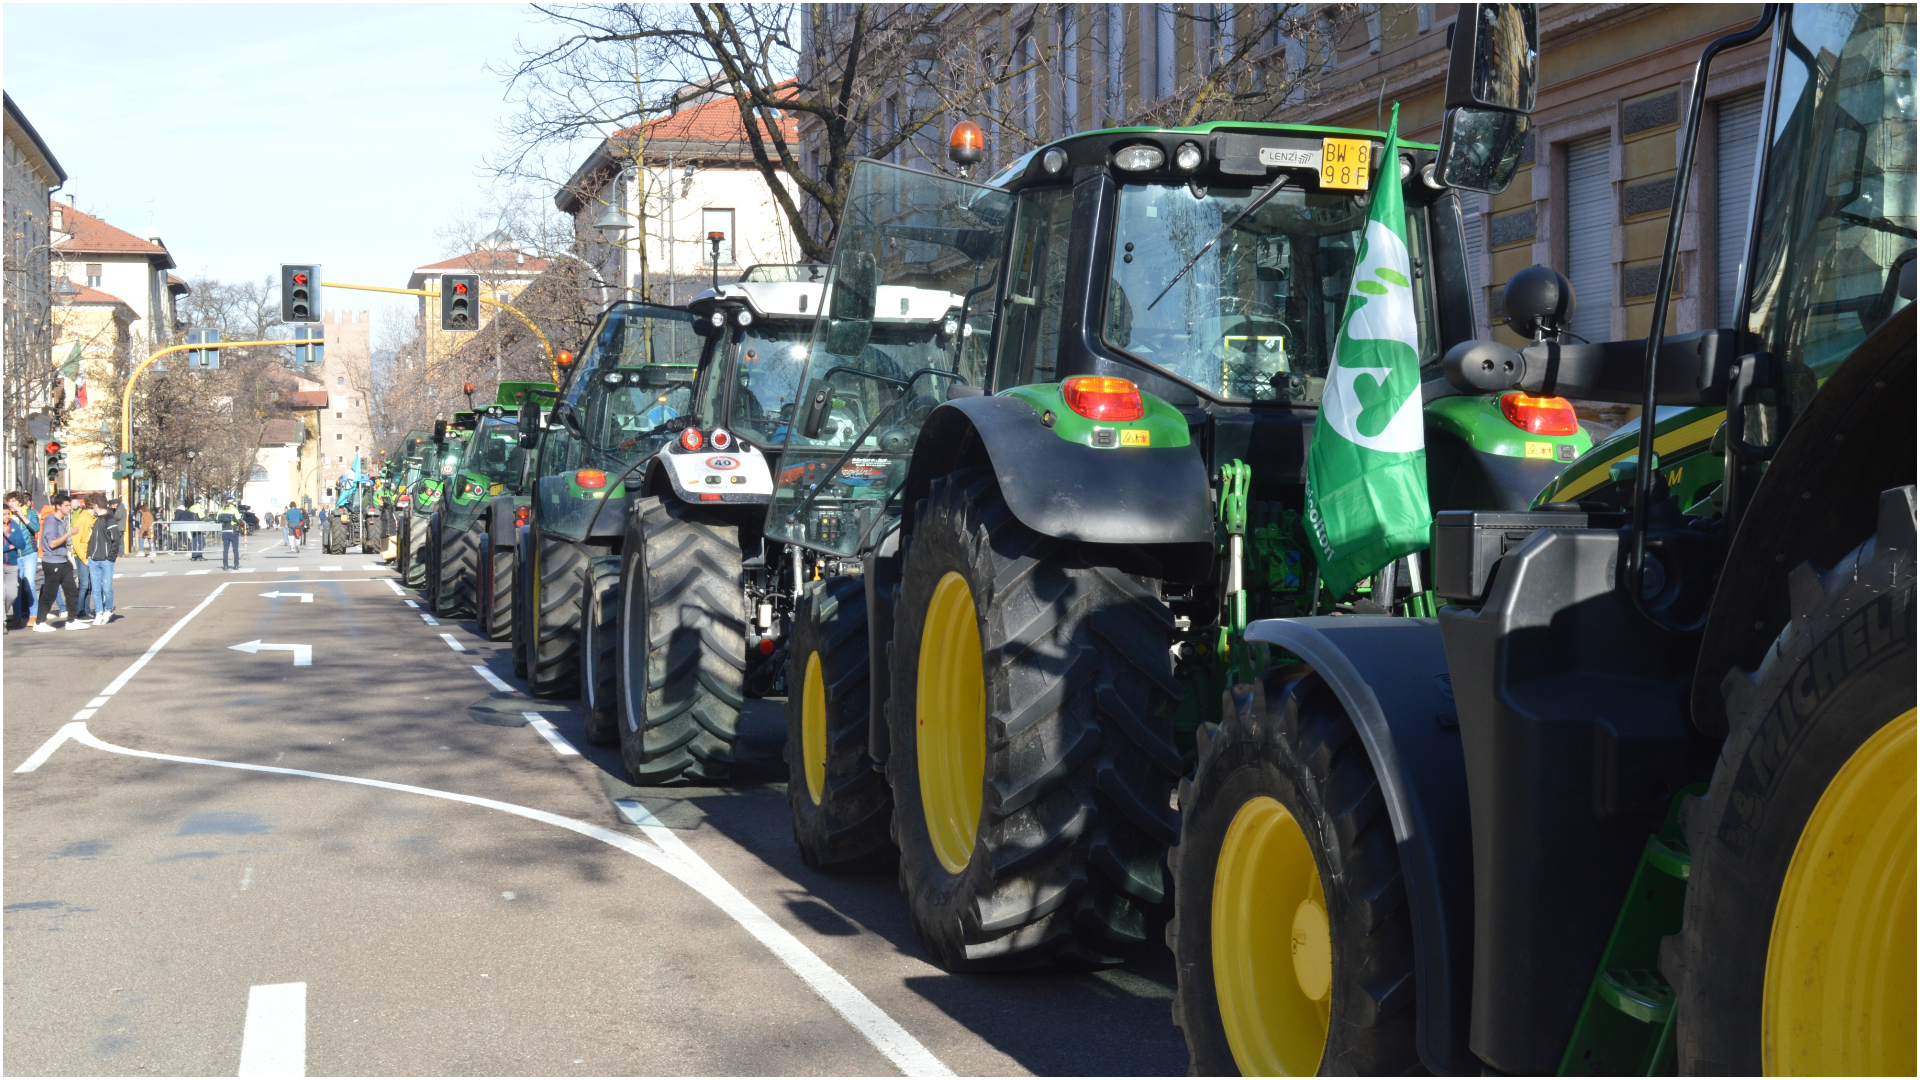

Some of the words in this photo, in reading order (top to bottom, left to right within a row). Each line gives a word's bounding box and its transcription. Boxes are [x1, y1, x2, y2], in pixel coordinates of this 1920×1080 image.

[1269, 152, 1298, 162] LENZI
[1326, 143, 1347, 163] BW
[1358, 145, 1368, 163] 8
[714, 459, 731, 467] 40
[1664, 466, 1684, 487] M
